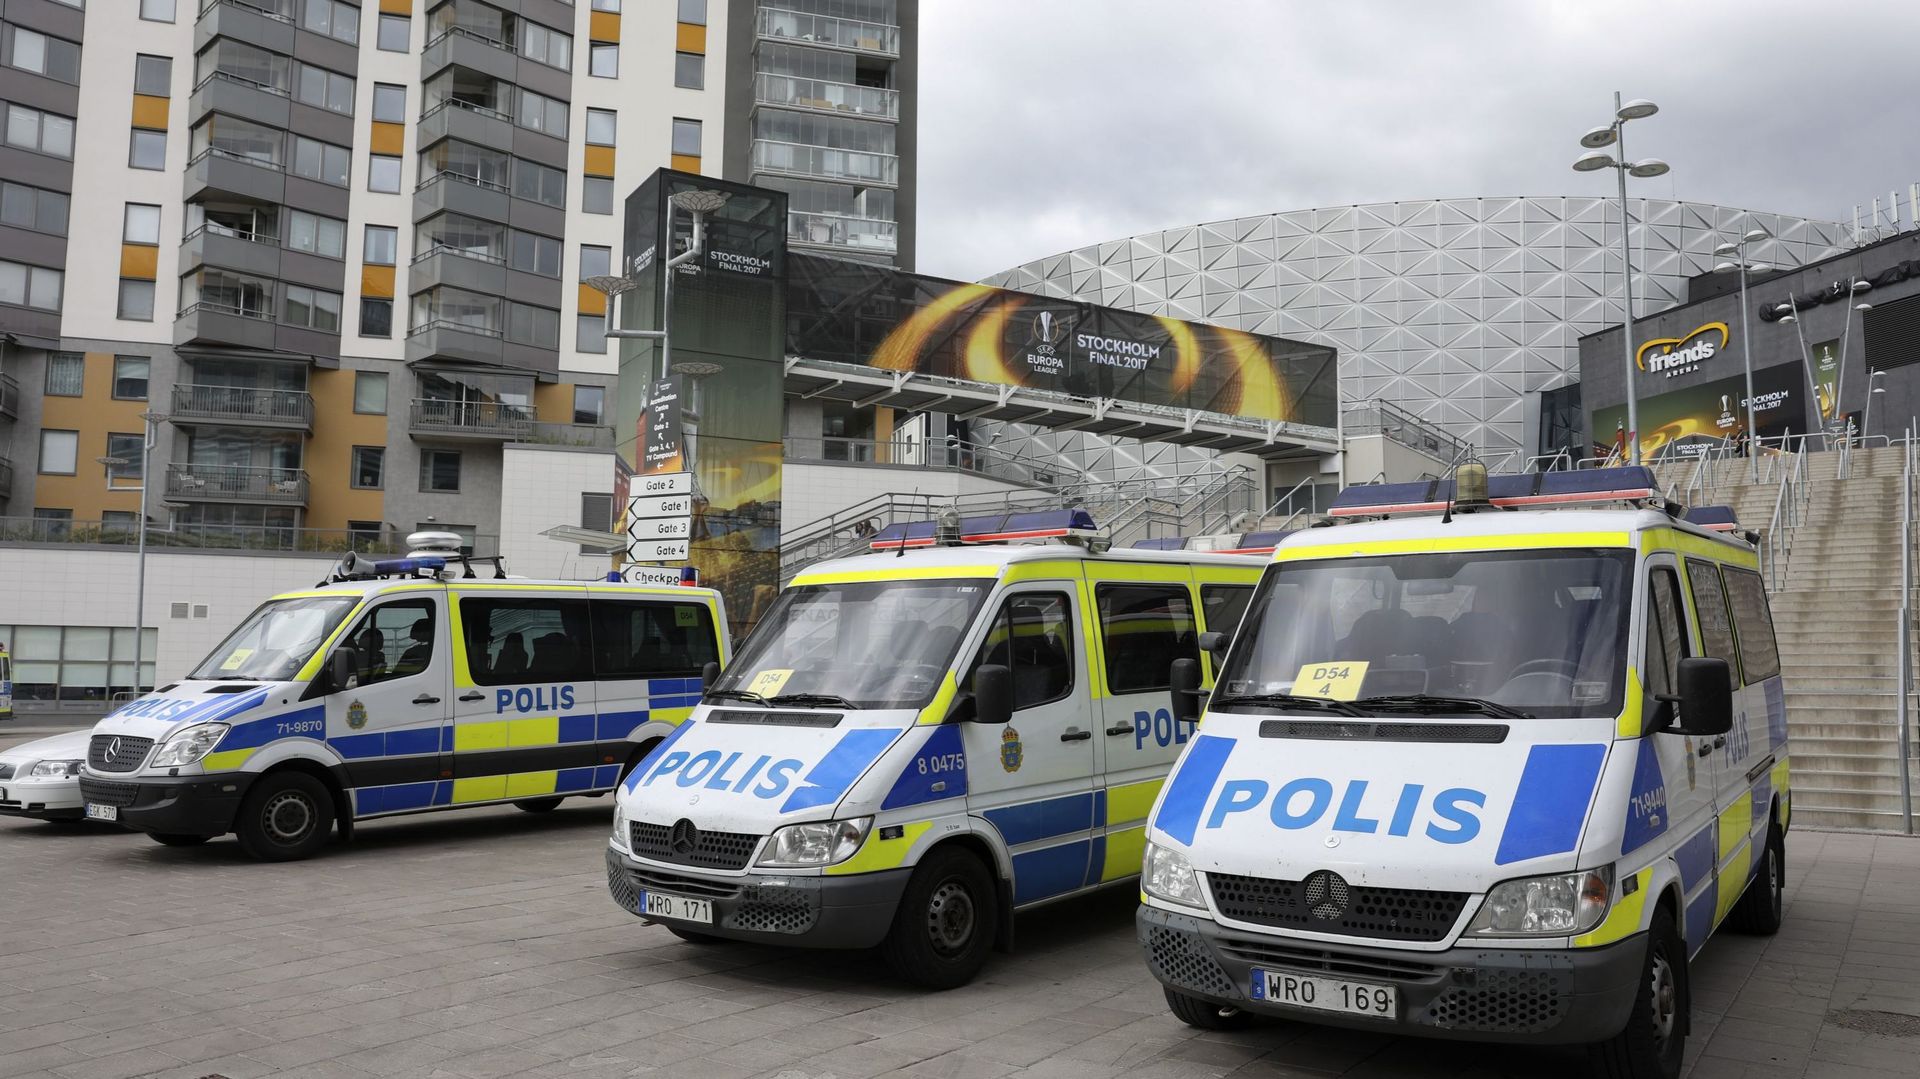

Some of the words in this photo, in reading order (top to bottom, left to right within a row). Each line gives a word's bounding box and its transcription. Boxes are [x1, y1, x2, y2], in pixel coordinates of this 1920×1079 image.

[711, 251, 770, 268] STOCKHOLM
[719, 262, 743, 273] FINAL
[743, 265, 761, 275] 2017
[1077, 334, 1160, 359] STOCKHOLM
[1027, 354, 1064, 368] EUROPA
[1089, 351, 1125, 367] FINAL
[1125, 356, 1148, 370] 2017
[1649, 341, 1714, 372] friends
[1033, 365, 1058, 375] LEAGUE
[1666, 365, 1699, 378] ARENA
[1741, 390, 1789, 407] SCKHOLM
[1752, 403, 1767, 411] NAL
[1767, 400, 1781, 409] 2017
[655, 404, 669, 412] Centre
[649, 444, 659, 453] Gate
[653, 450, 678, 460] Compound
[646, 481, 666, 490] Gate
[669, 479, 674, 489] 2
[661, 501, 681, 511] Gate
[684, 501, 688, 510] 1
[658, 524, 678, 533] Gate
[681, 523, 686, 532] 3
[656, 546, 676, 555] Gate
[679, 545, 684, 554] 4
[635, 571, 680, 585] Checkpo
[760, 673, 783, 684] D54
[1313, 666, 1350, 680] D54
[1319, 683, 1331, 695] 4
[496, 685, 574, 714] POLIS
[120, 699, 195, 721] POLIS
[276, 720, 322, 734] 71-9870
[918, 758, 928, 775] 8
[931, 753, 964, 773] 0475
[643, 750, 804, 799] POLIS
[104, 806, 116, 819] 570
[1206, 777, 1487, 844] POLIS
[647, 895, 672, 914] WRO
[684, 900, 708, 921] 171
[1268, 975, 1315, 1003] WRO
[1340, 985, 1389, 1013] 169
